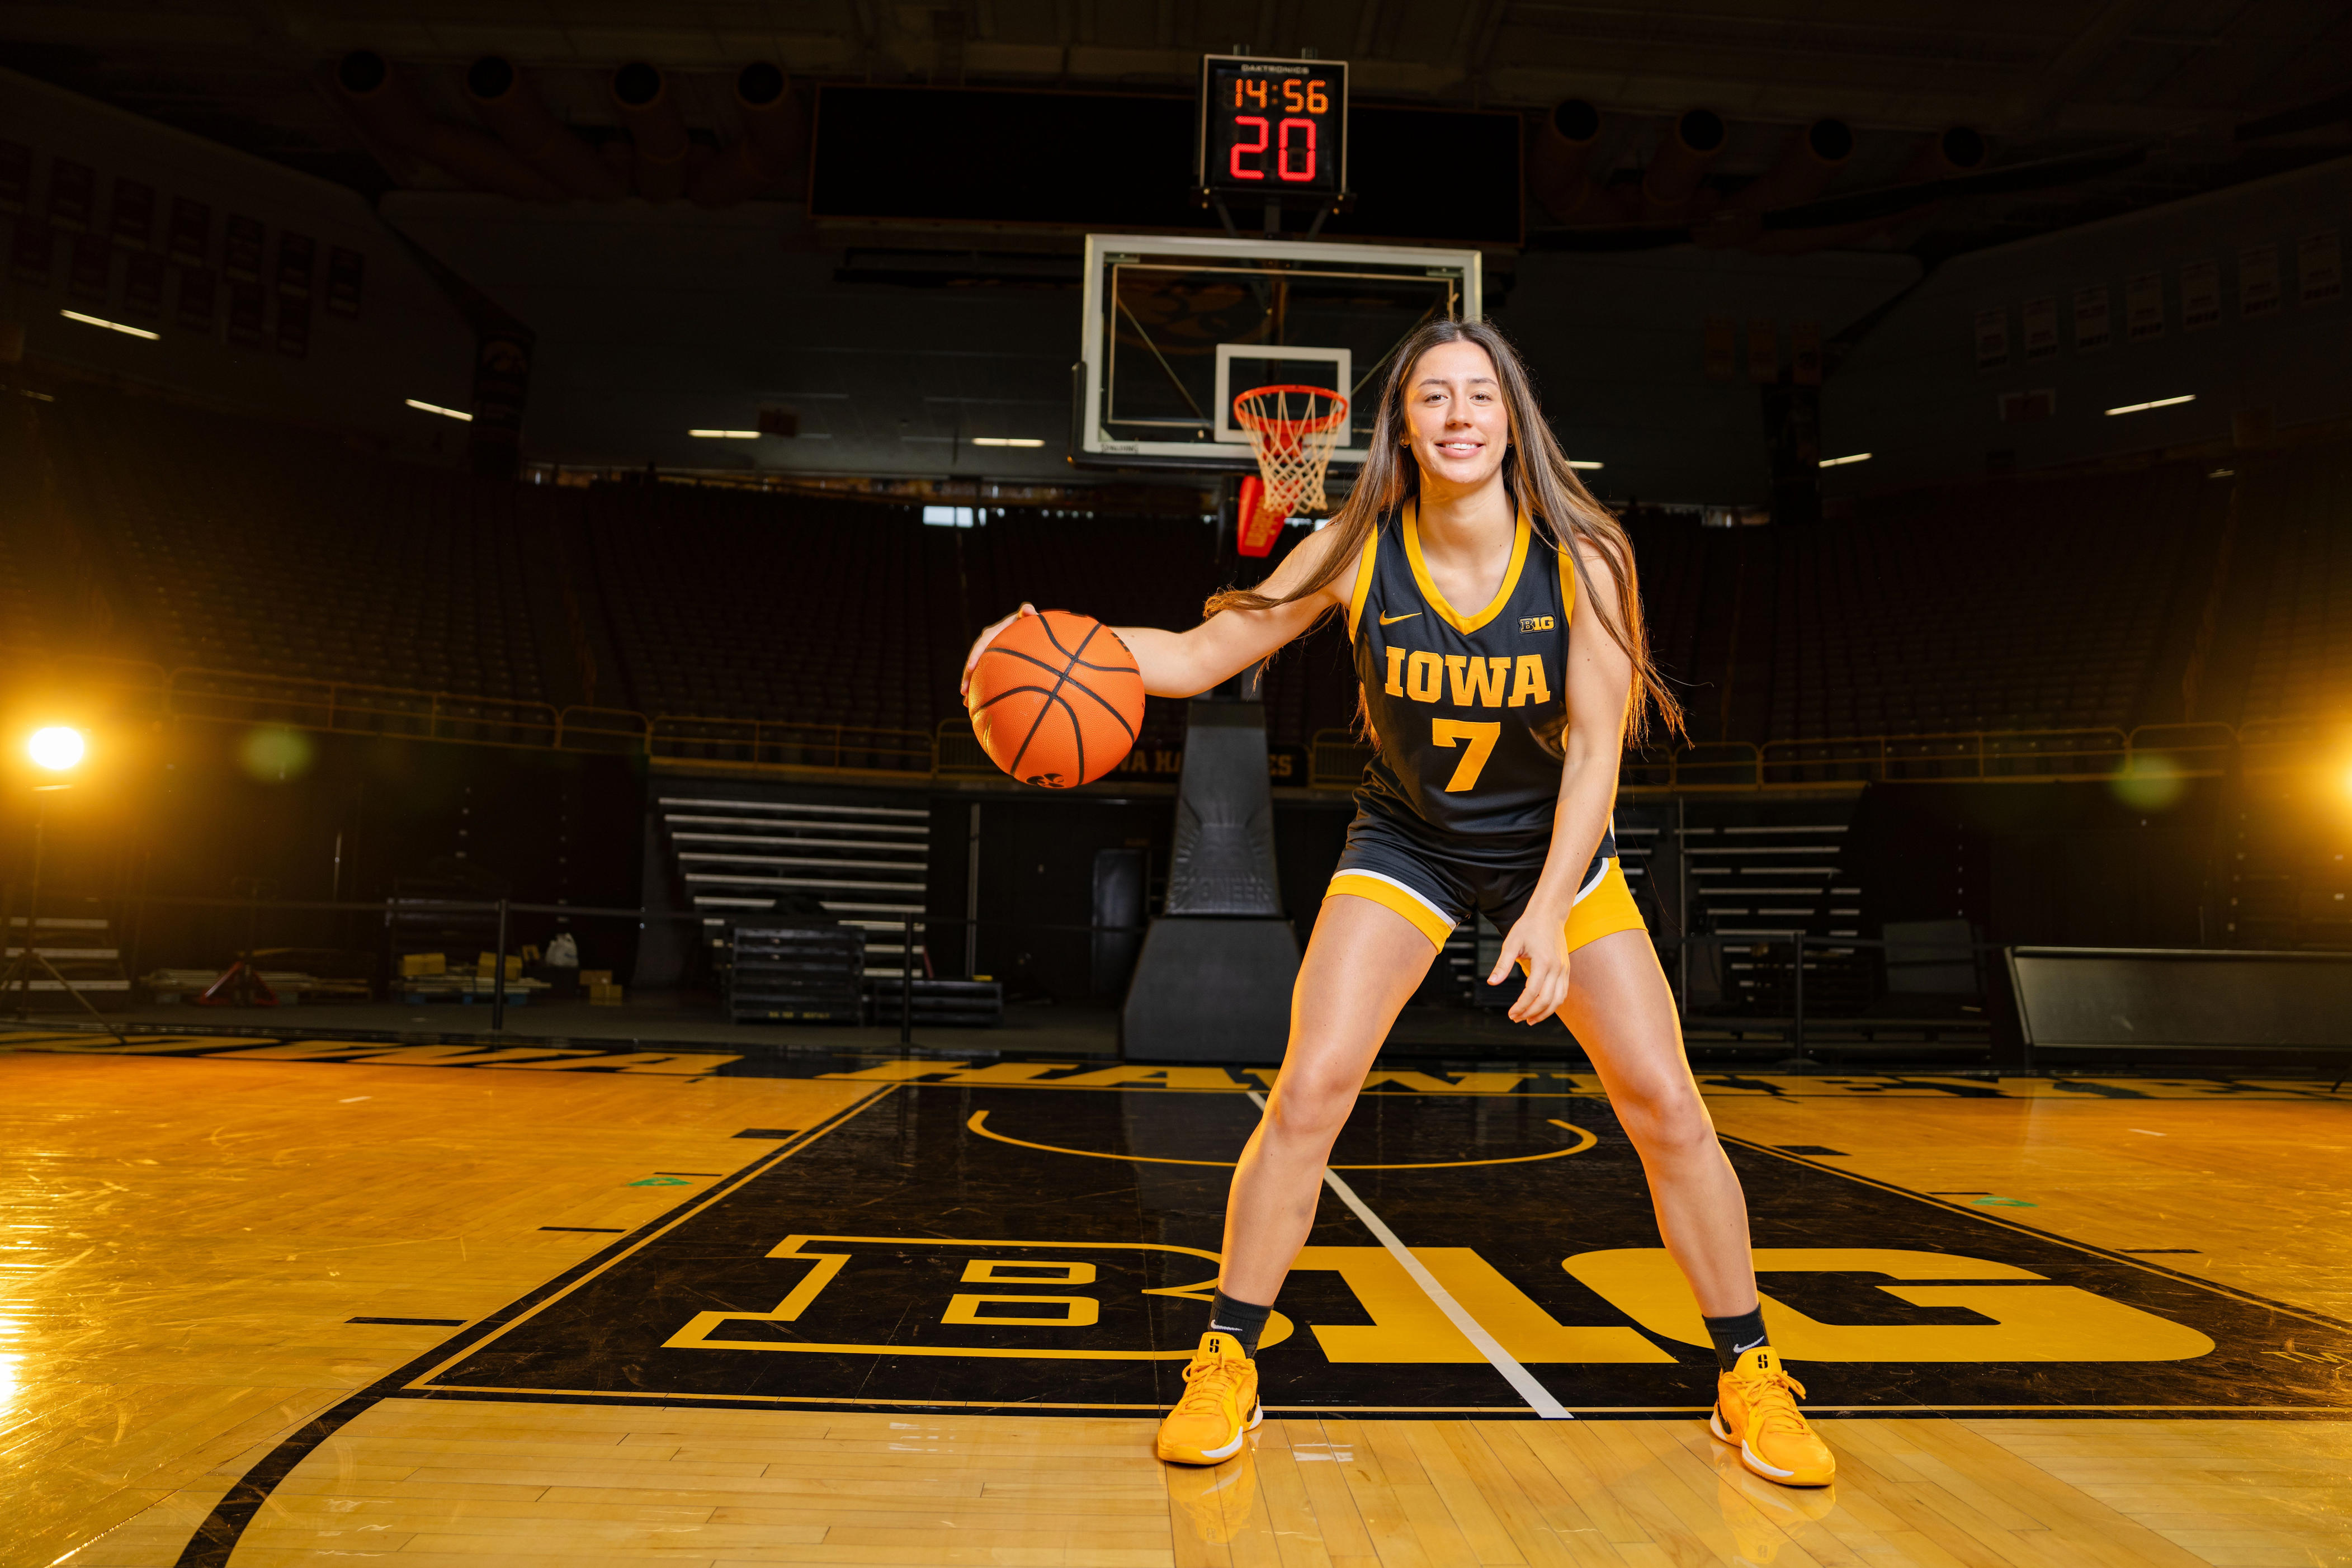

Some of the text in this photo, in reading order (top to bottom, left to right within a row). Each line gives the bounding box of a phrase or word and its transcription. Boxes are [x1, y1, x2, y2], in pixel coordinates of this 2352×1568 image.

[1235, 78, 1329, 114] 14:56
[1230, 116, 1316, 182] 20
[1385, 645, 1551, 708] IOWA
[1432, 717, 1501, 792] 7
